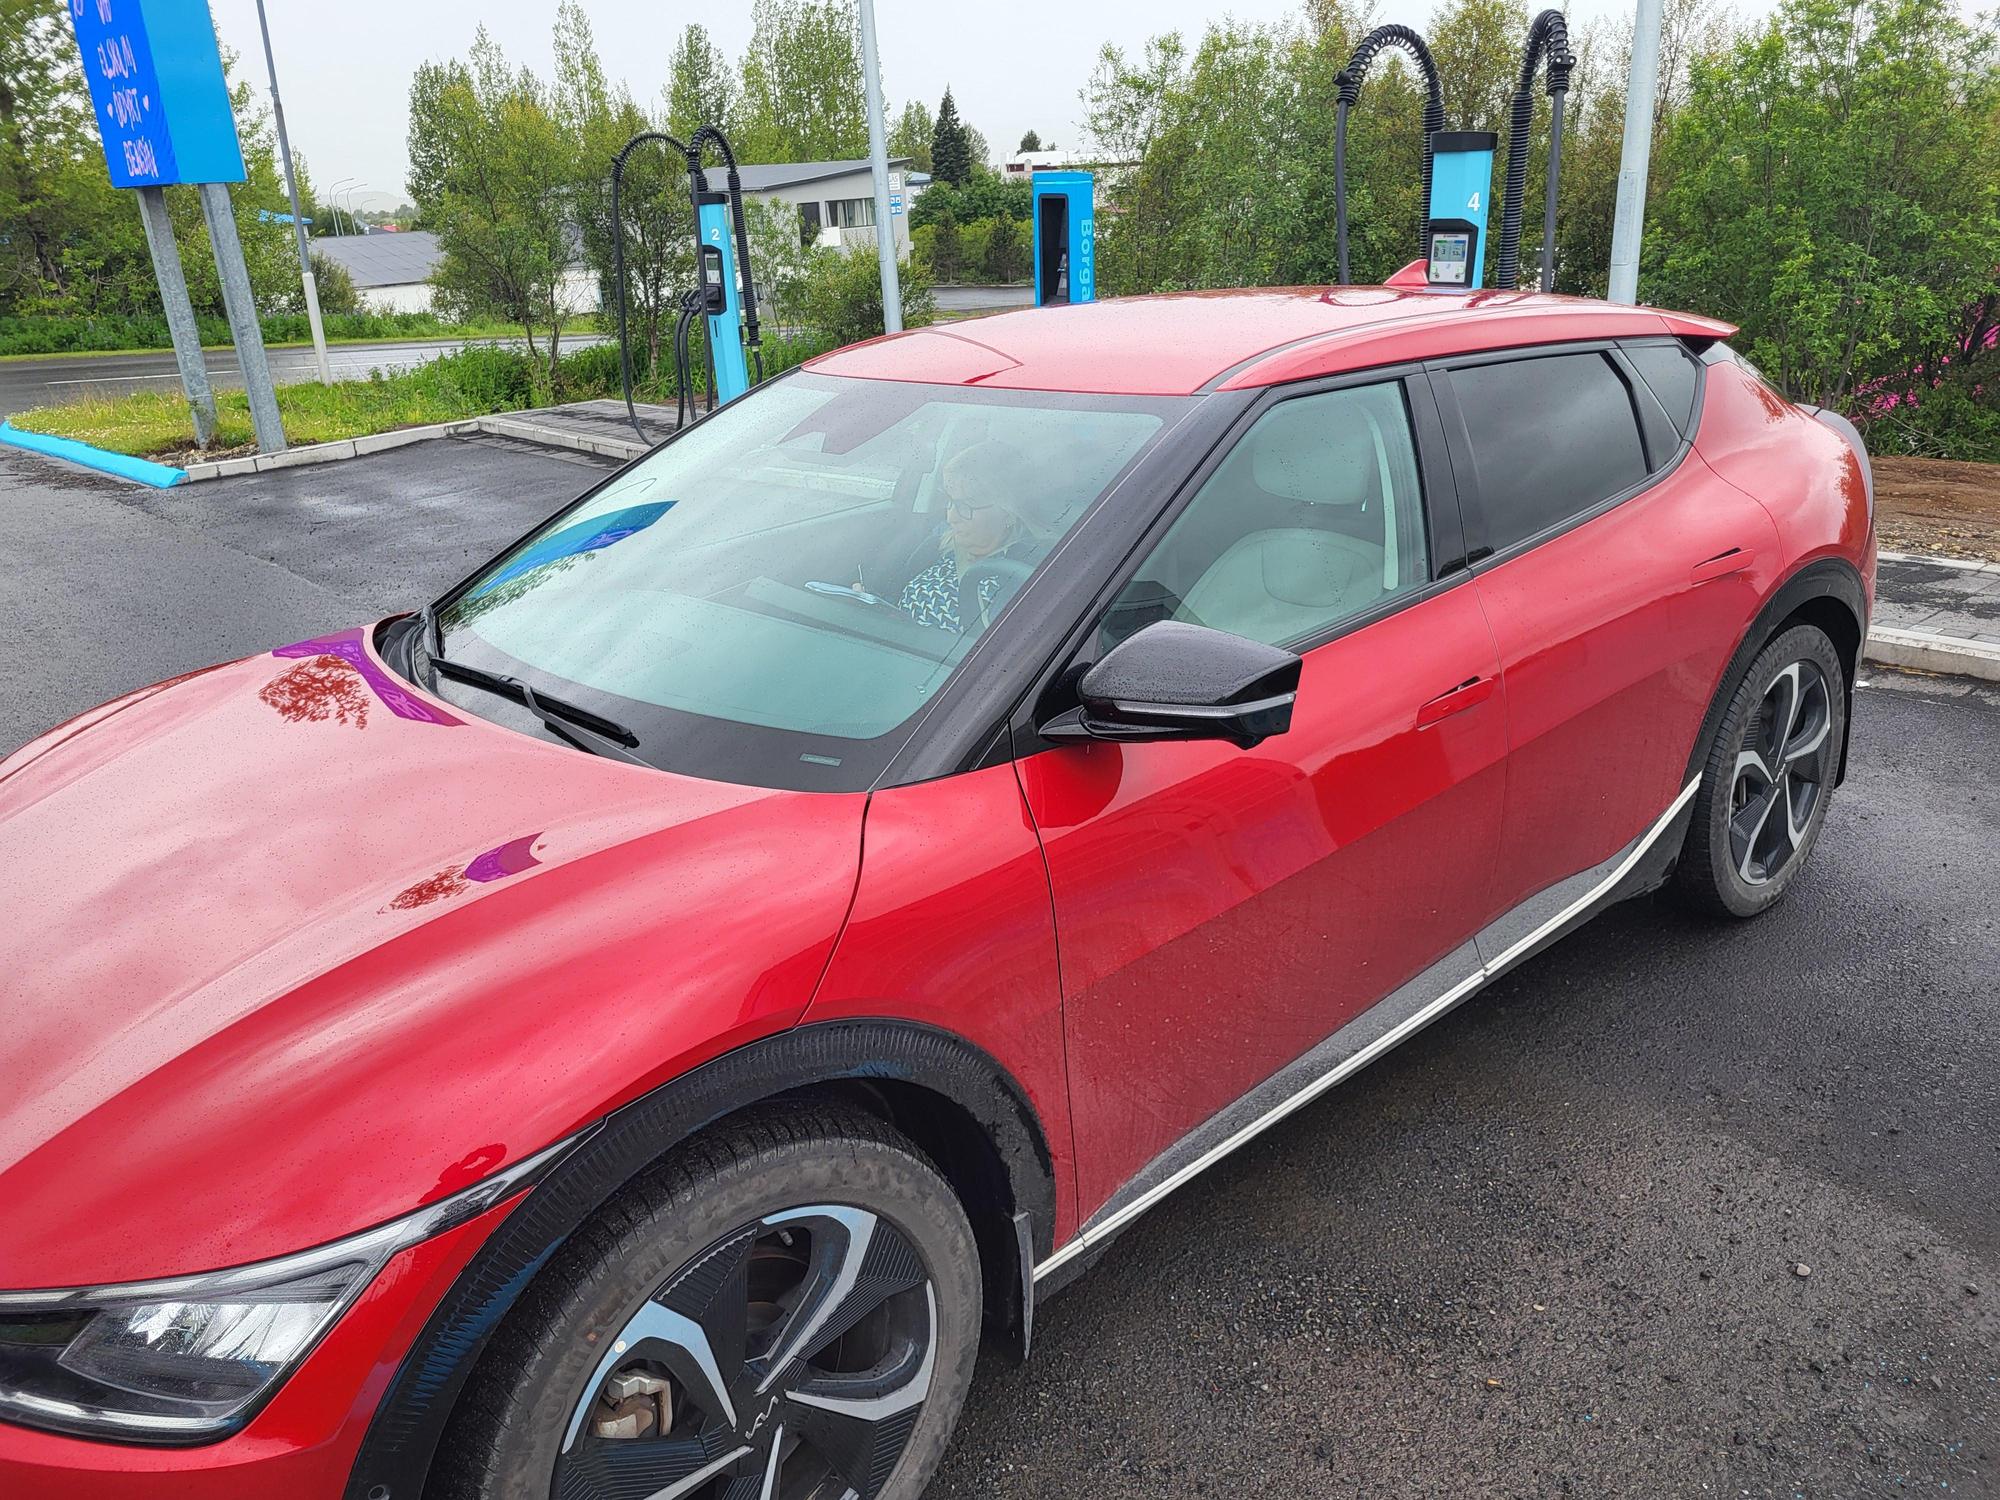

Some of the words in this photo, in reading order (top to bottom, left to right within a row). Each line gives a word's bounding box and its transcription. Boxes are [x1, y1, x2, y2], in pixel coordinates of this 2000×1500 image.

[1467, 192, 1480, 211] 4
[711, 228, 720, 241] 2
[1079, 219, 1092, 301] Borga
